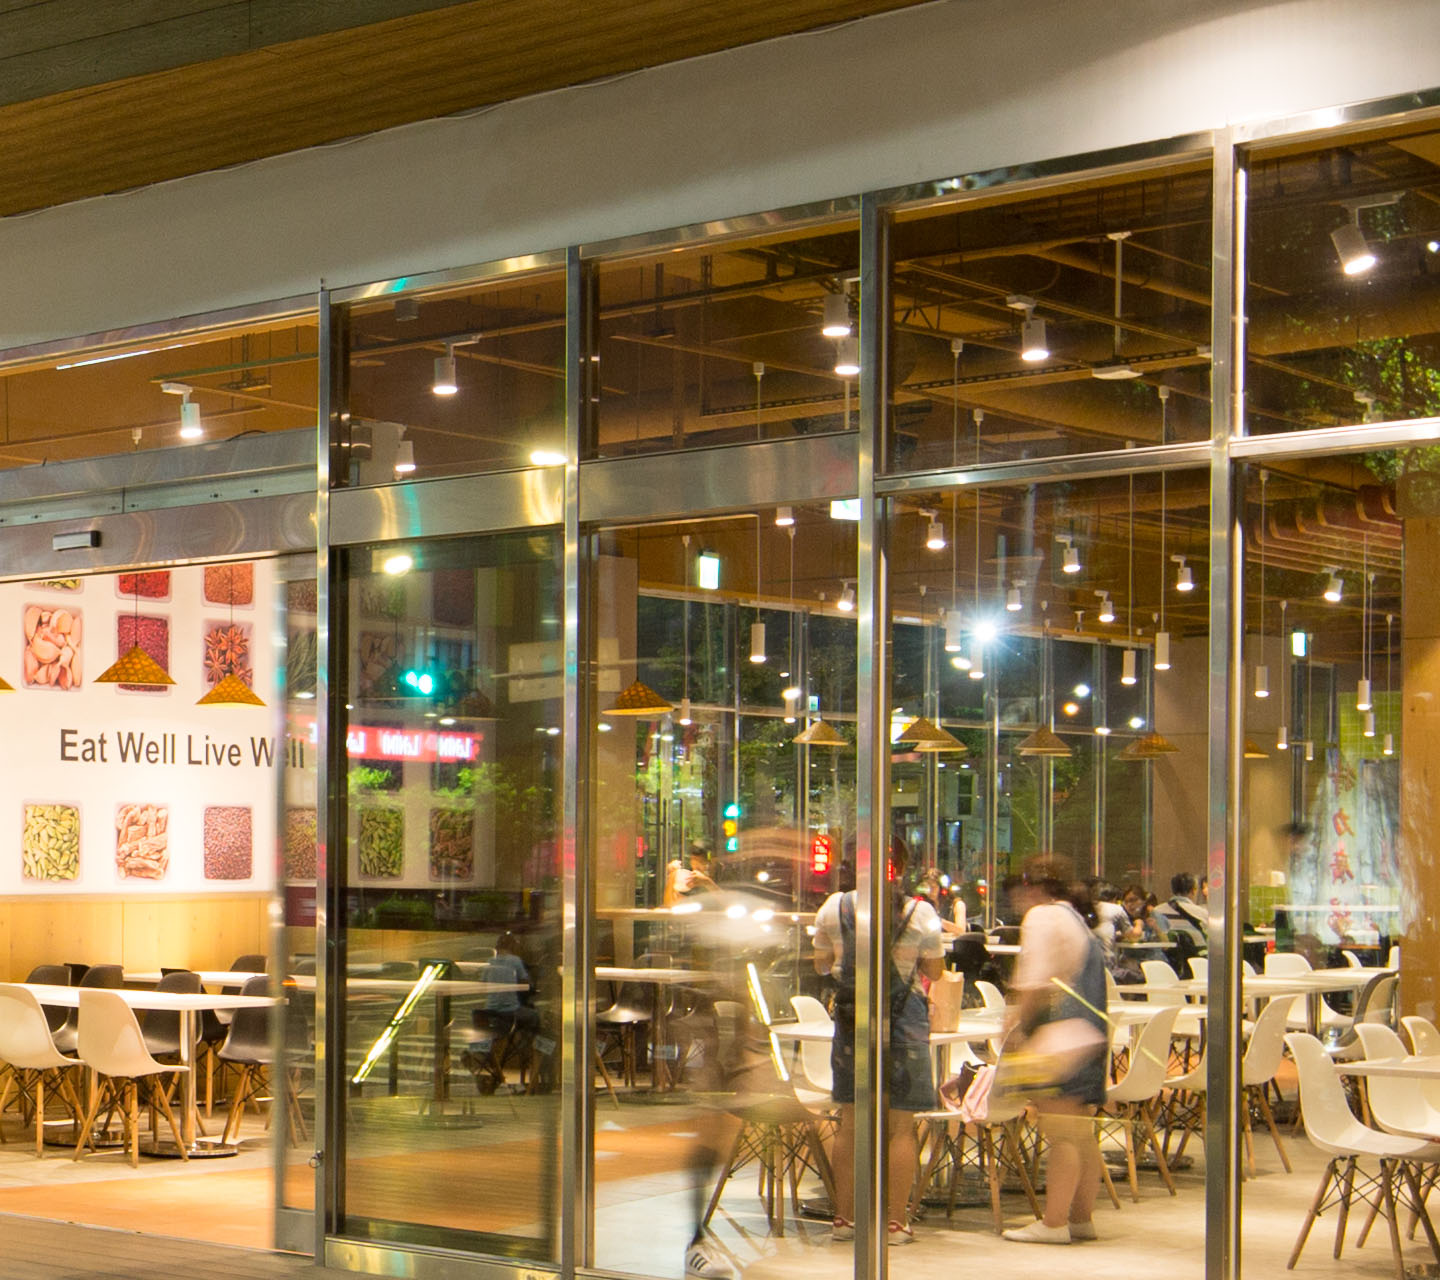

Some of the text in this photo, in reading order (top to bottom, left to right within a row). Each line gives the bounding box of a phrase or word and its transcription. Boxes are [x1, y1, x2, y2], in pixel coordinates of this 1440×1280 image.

[60, 729, 107, 763] Eat
[117, 731, 175, 764] Well
[187, 734, 241, 767] Live
